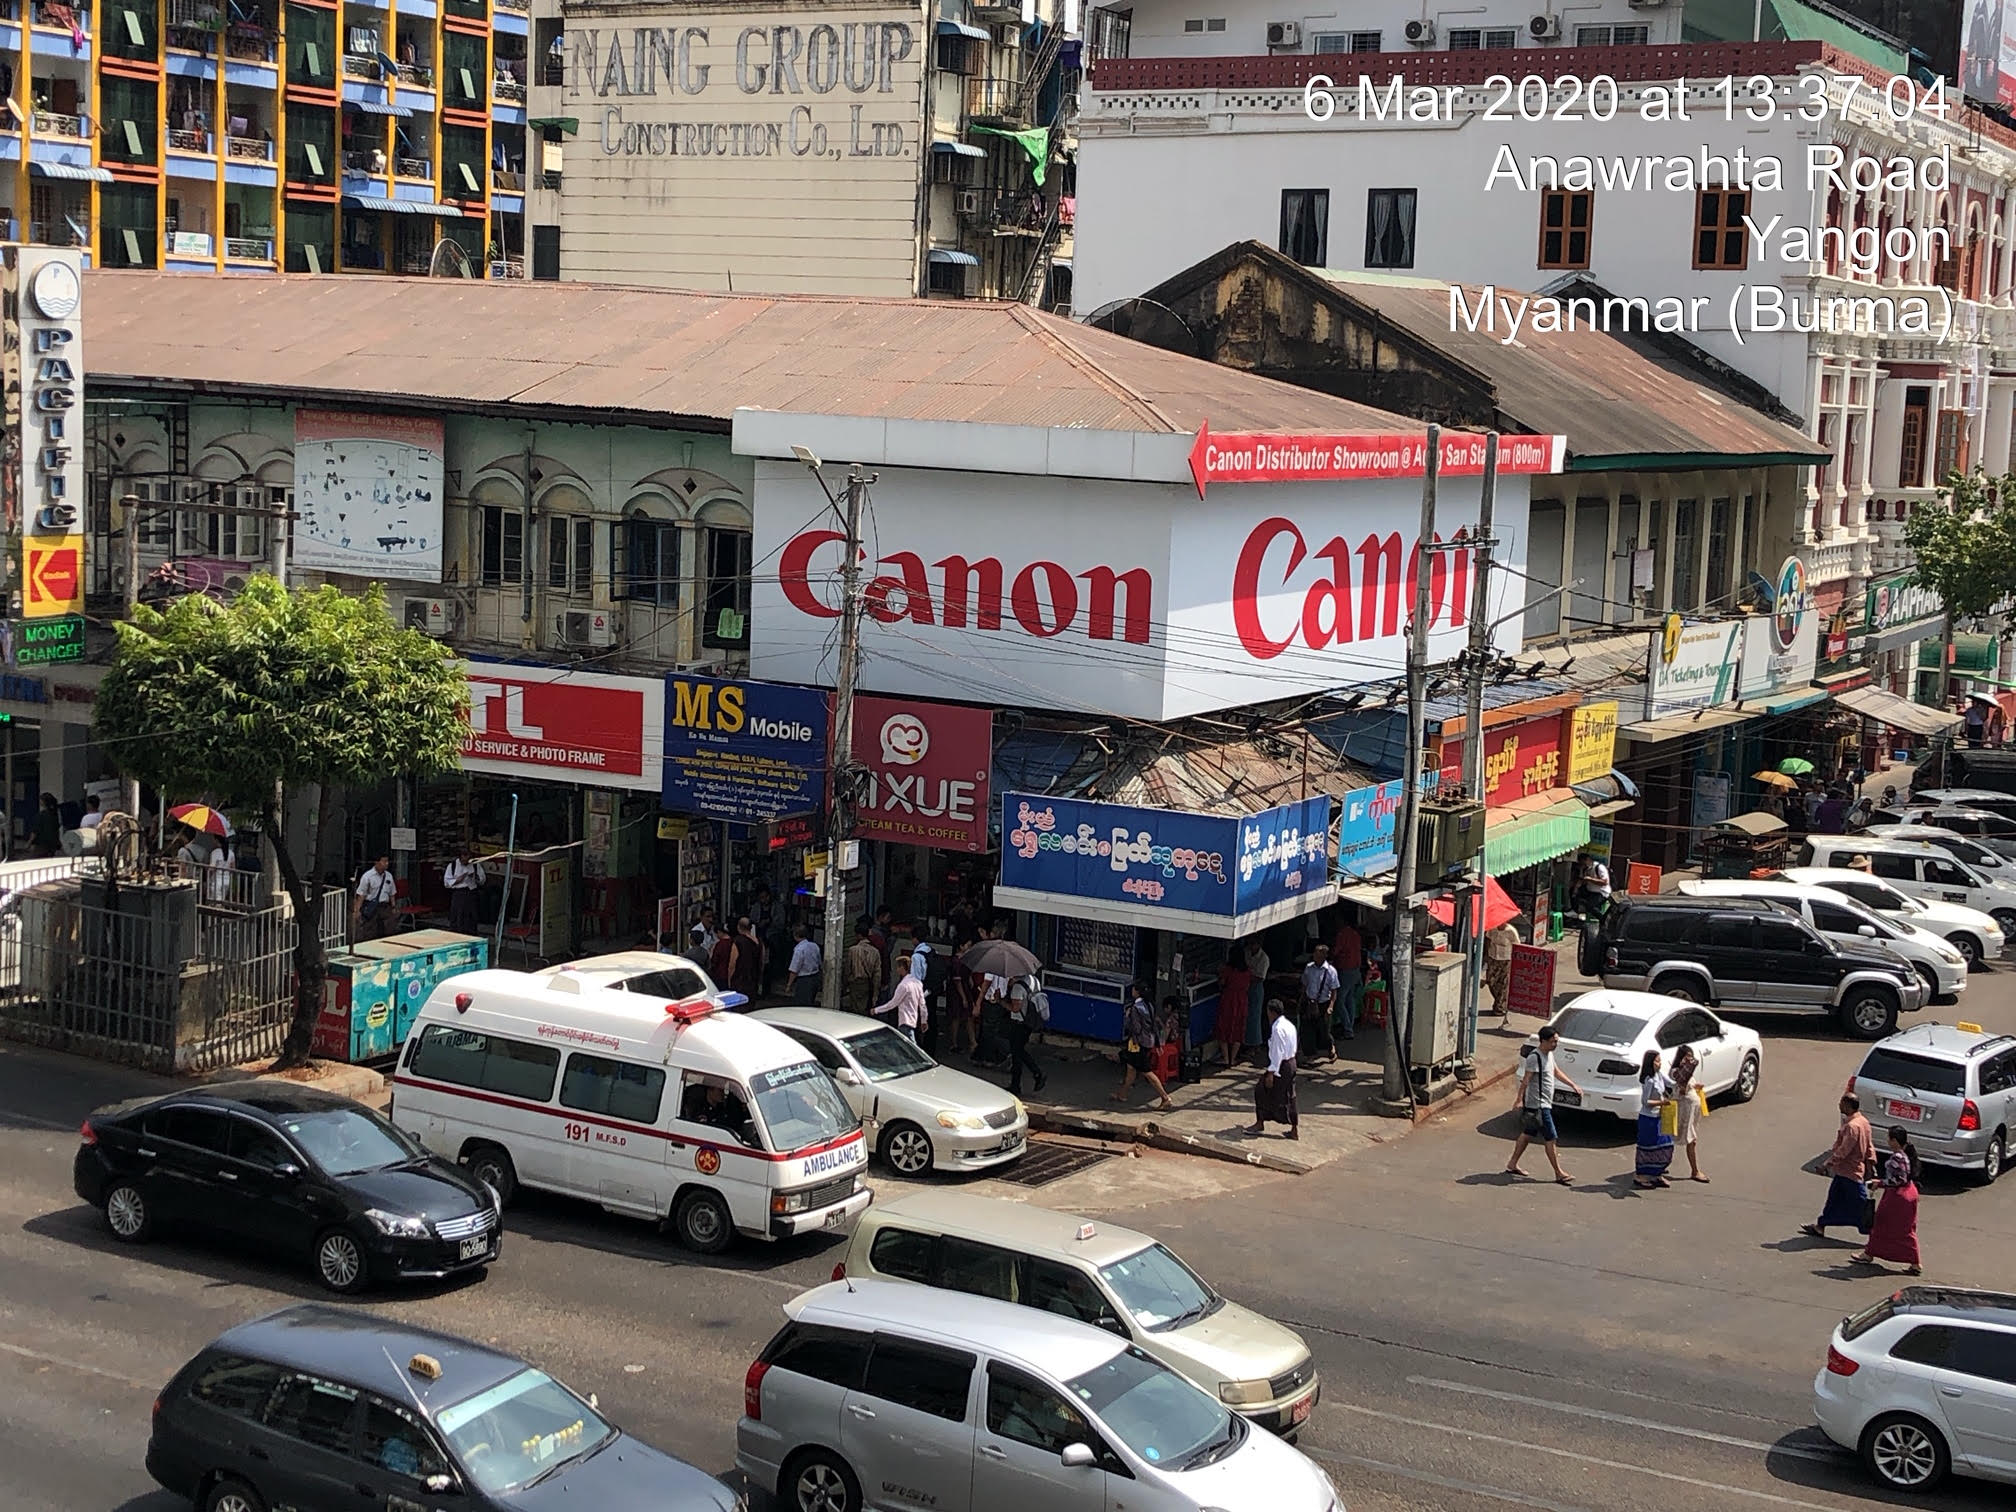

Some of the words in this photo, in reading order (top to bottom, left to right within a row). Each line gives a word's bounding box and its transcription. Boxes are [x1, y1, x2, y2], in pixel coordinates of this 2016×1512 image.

[569, 26, 710, 97] NAING
[736, 22, 914, 96] GROUP
[34, 327, 78, 530] PACIFIC
[1205, 445, 1252, 472] Canon
[1256, 445, 1330, 471] Distributor
[1333, 445, 1399, 471] Showroom
[1401, 446, 1411, 469] @
[1446, 443, 1468, 466] San
[1470, 443, 1511, 466] Staum
[1512, 443, 1545, 470] (800m)
[778, 528, 1153, 644] Canon
[26, 624, 75, 643] MONEY
[672, 681, 745, 733] MS
[749, 716, 813, 742] Mobile
[475, 740, 519, 758] SERVICE
[520, 745, 529, 758] &
[530, 746, 566, 763] PHOTO
[568, 750, 606, 767] FRAME
[896, 821, 915, 834] TEA
[917, 825, 925, 835] &
[928, 826, 968, 842] COFFEE
[564, 1122, 590, 1143] 191
[803, 1143, 860, 1178] AMBULANCE
